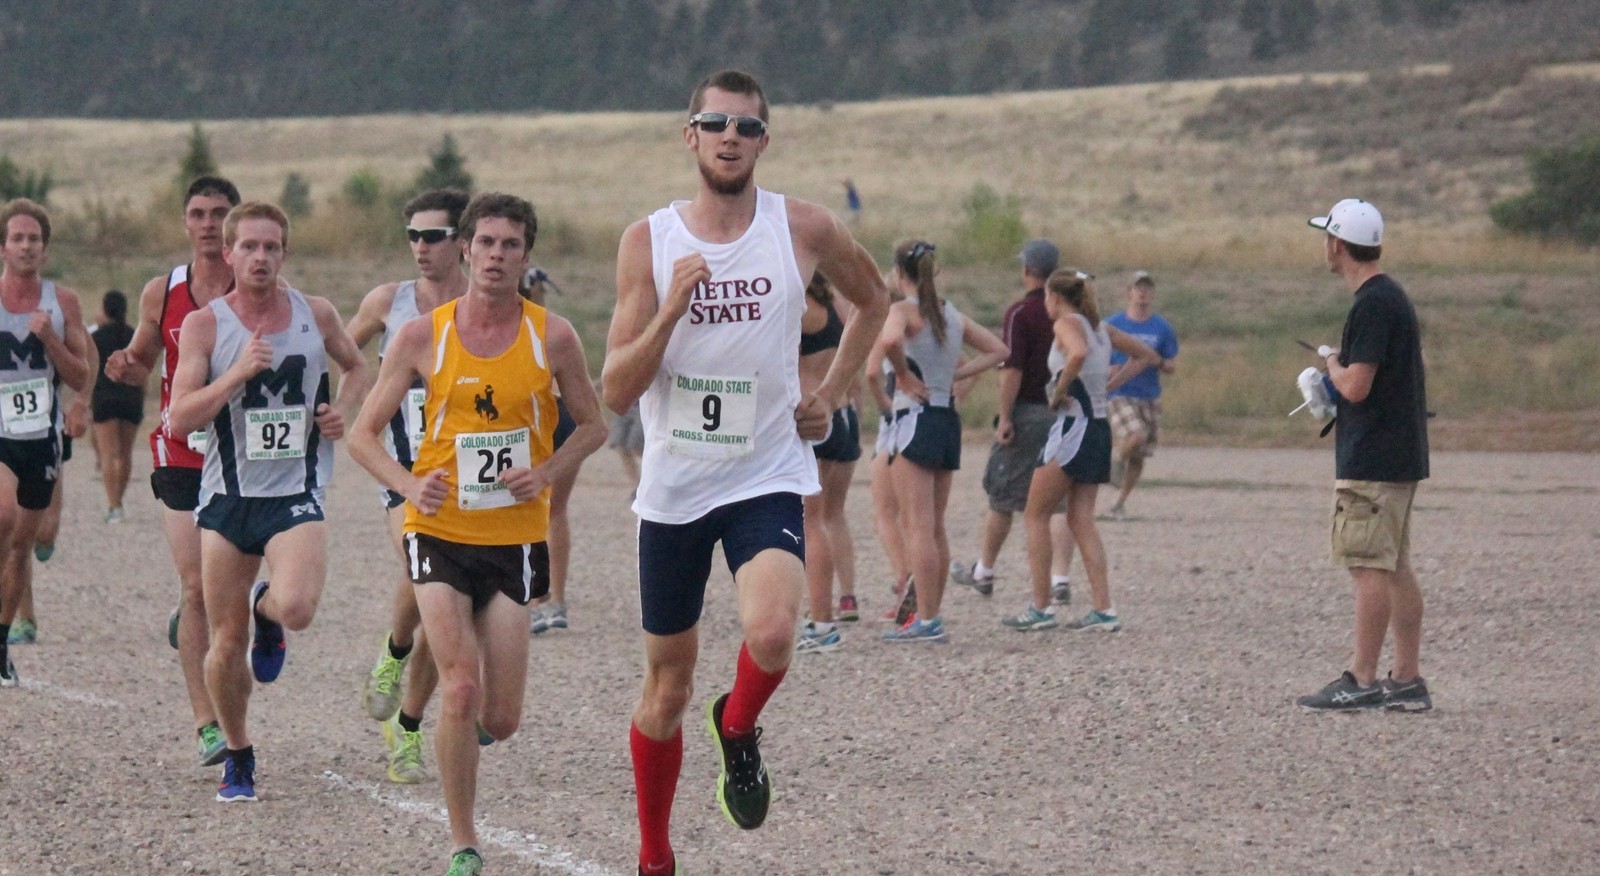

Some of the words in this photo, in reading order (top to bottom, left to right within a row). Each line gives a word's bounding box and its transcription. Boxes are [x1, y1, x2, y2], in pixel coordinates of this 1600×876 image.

[689, 301, 762, 325] STATE
[0, 331, 48, 370] M
[241, 354, 307, 409] M
[677, 375, 723, 394] COLORADO
[725, 380, 752, 394] STATE
[13, 390, 38, 415] 93
[702, 394, 722, 432] 9
[250, 412, 284, 423] COLORADO
[285, 411, 302, 420] STATE
[262, 422, 291, 450] 92
[461, 435, 504, 449] COLORADO
[505, 431, 526, 446] STATE
[672, 429, 703, 441] CROSS
[705, 432, 748, 444] COUNTRY
[477, 447, 513, 483] 26
[463, 484, 491, 493] CROSS
[289, 502, 318, 518] M
